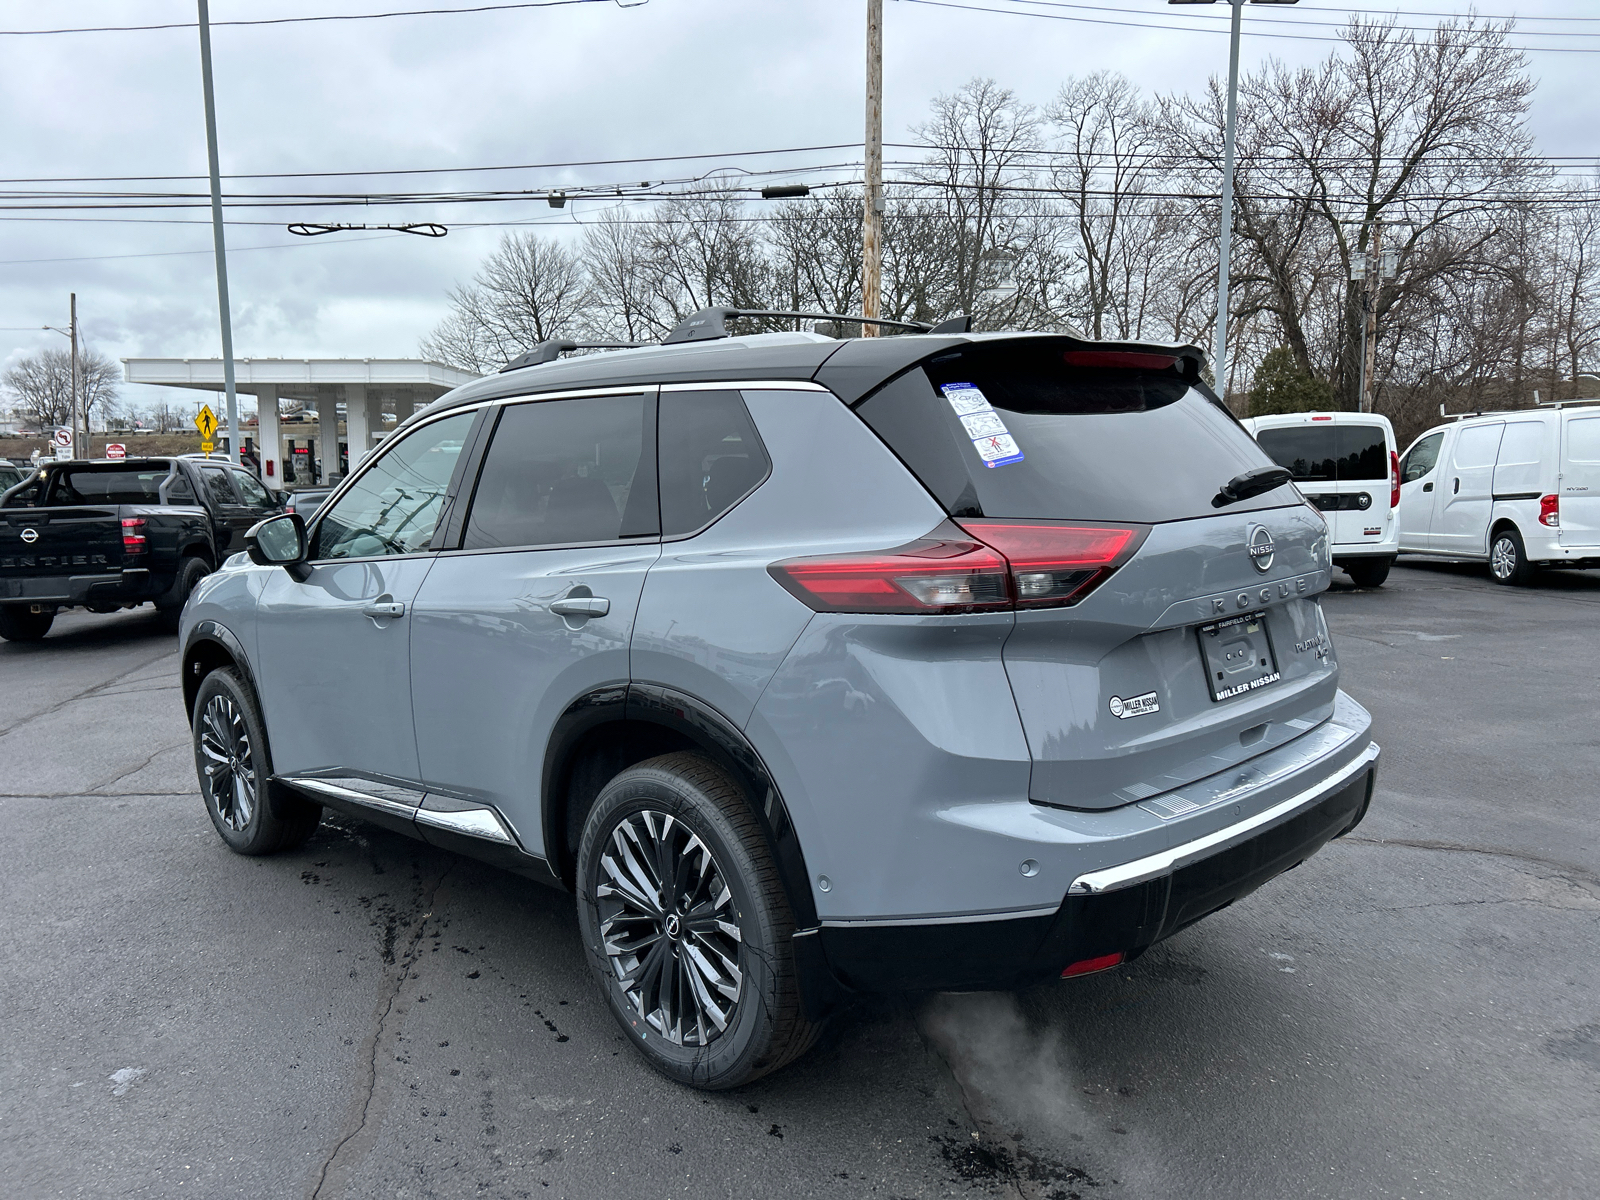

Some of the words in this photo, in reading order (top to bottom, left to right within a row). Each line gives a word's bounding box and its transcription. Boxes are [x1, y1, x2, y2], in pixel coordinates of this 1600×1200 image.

[1211, 578, 1307, 615] ROGUE
[1244, 614, 1252, 622] CT
[1216, 683, 1250, 701] MILLER
[1250, 672, 1281, 689] NISSAN
[1123, 699, 1142, 711] MILLER
[1141, 696, 1158, 707] NISSAN
